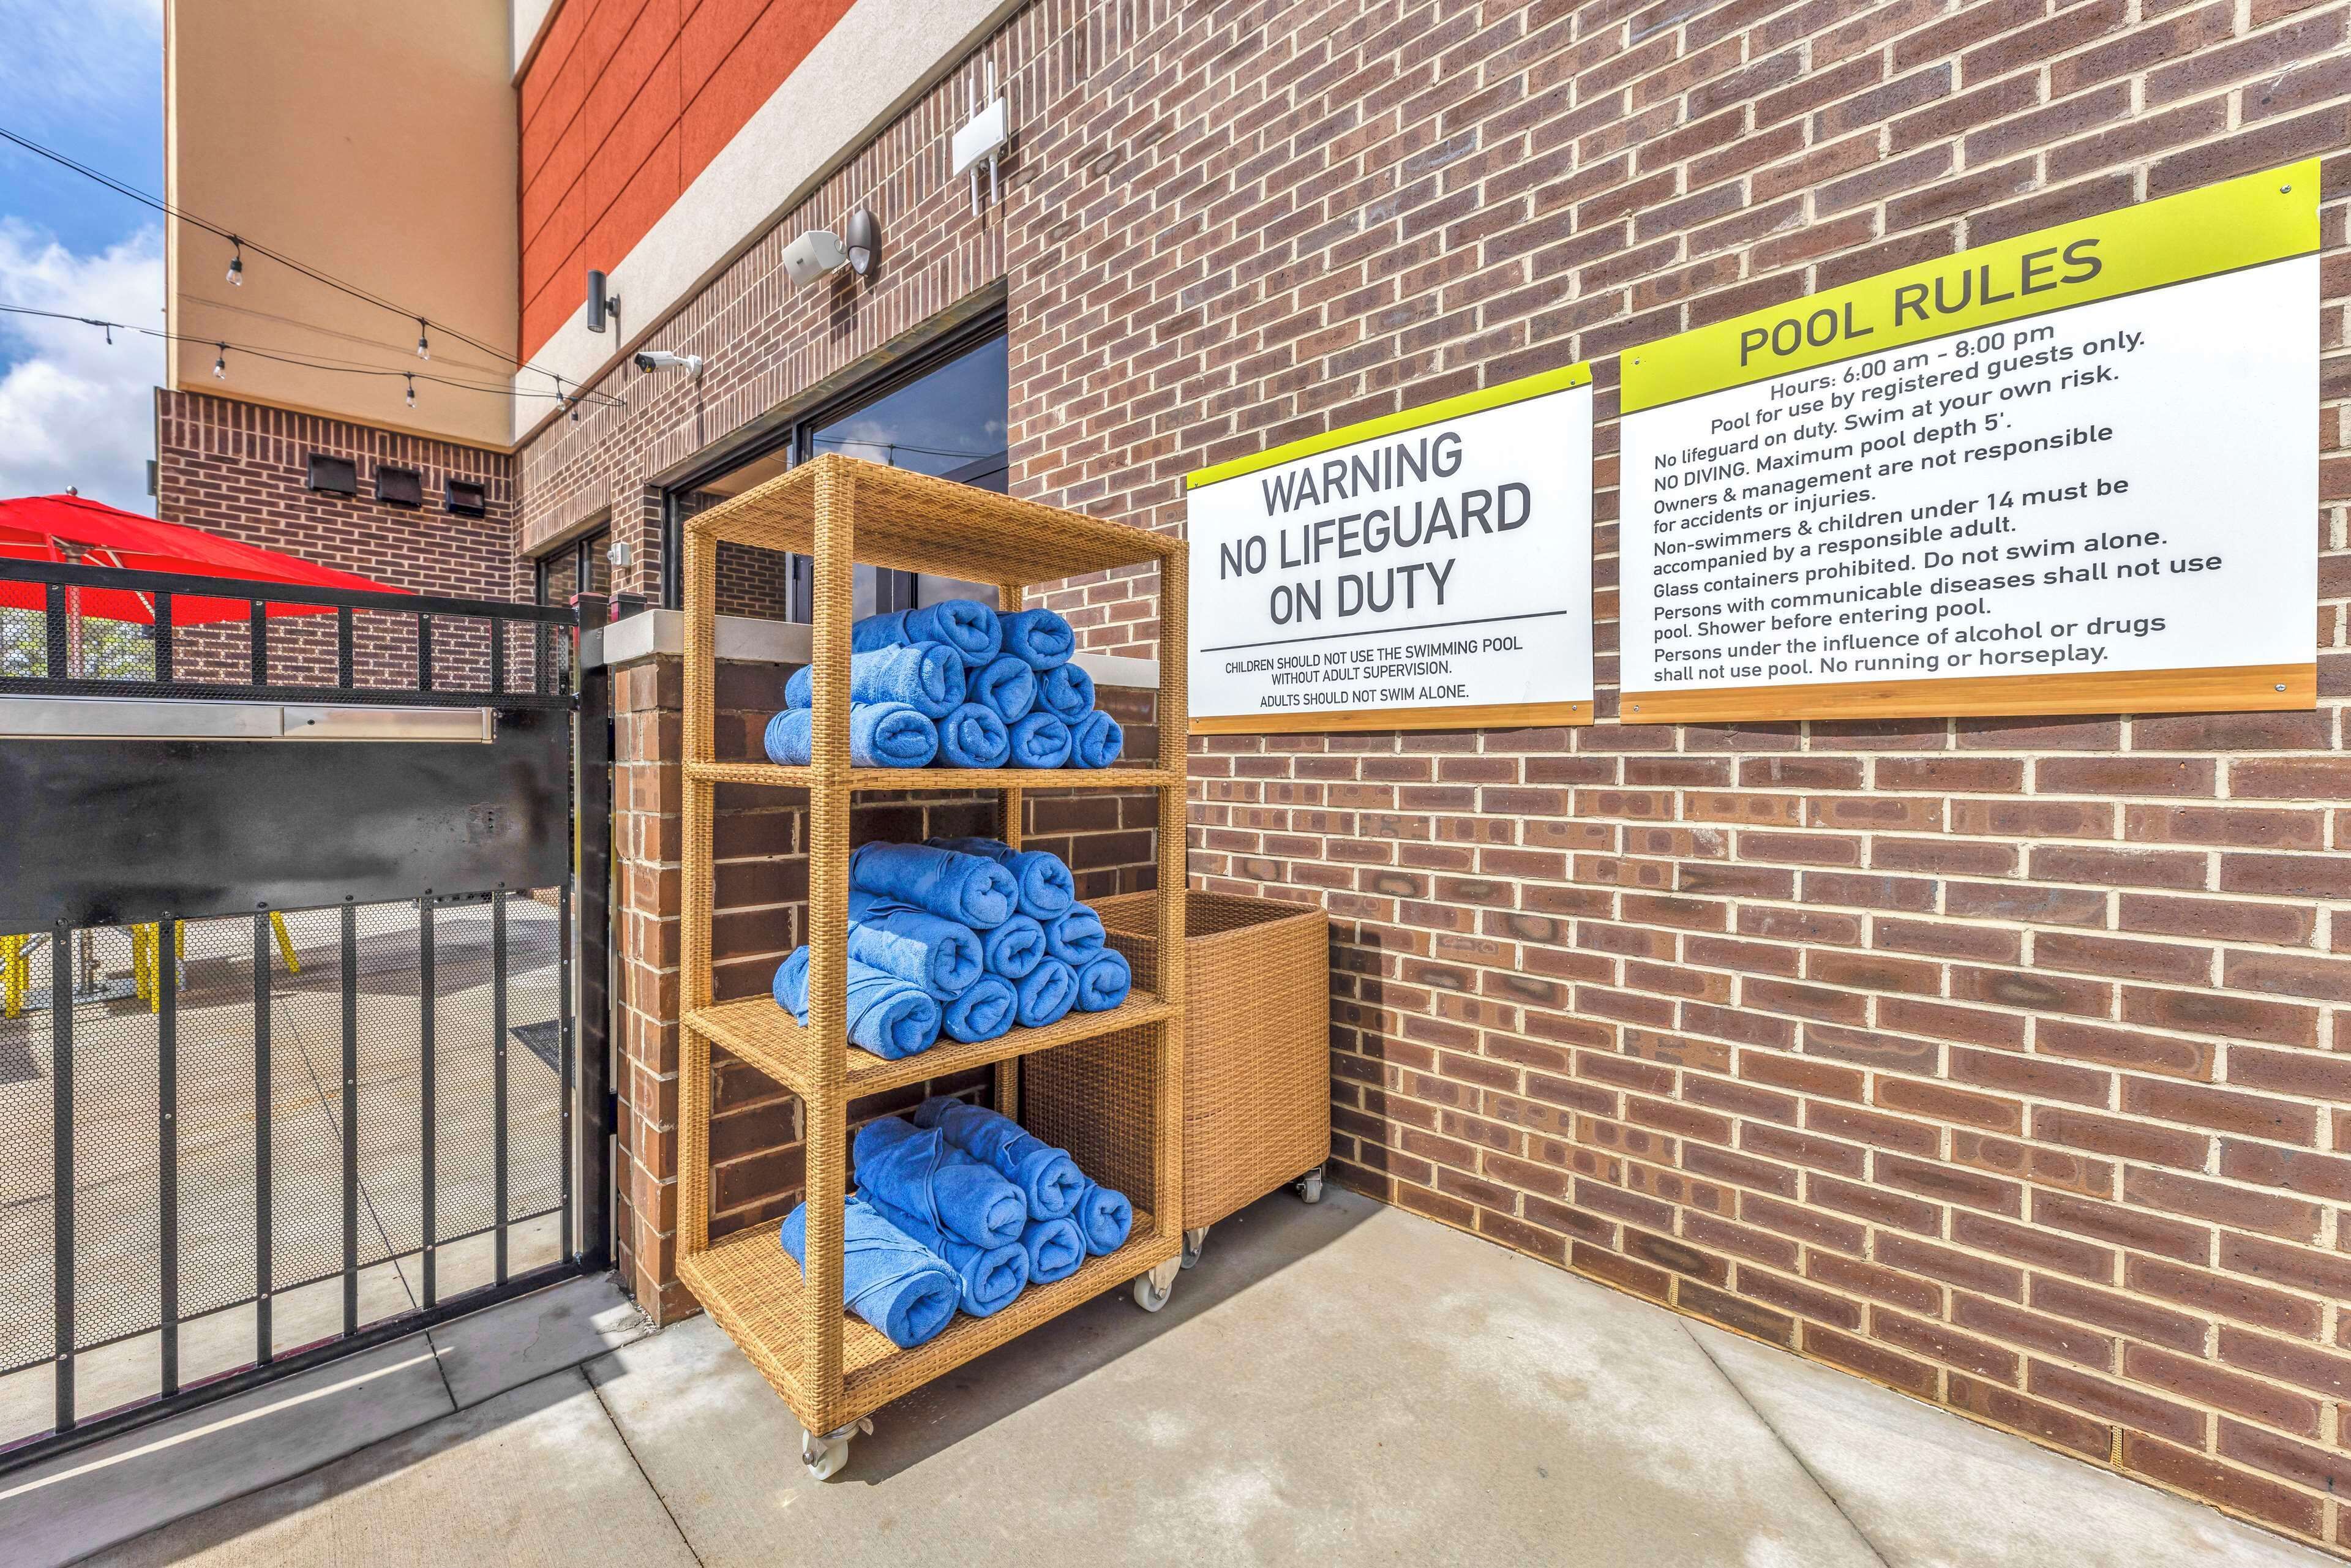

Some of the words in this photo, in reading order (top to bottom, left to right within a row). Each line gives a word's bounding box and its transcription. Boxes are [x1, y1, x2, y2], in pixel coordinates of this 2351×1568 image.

[1741, 302, 1873, 367] POOL
[1895, 239, 2101, 326] RULES
[1712, 412, 1750, 434] Pool
[1756, 409, 1783, 424] for
[1790, 400, 1823, 416] use
[1832, 392, 1854, 410] by
[1862, 361, 1978, 402] registered
[1988, 346, 2073, 380] guests
[2083, 331, 2144, 355] only.
[1771, 377, 1835, 400] Hours:
[1843, 360, 1885, 383] 6:00
[1894, 354, 1928, 372] am
[1955, 333, 2004, 358] 8:00
[2014, 326, 2053, 350] pm
[1655, 454, 1676, 469] No
[1682, 435, 1758, 463] lifeguard
[1765, 433, 1786, 446] on
[1794, 422, 1837, 440] duty.
[1845, 409, 1903, 430] Swim
[1912, 400, 1932, 417] at
[1939, 391, 1992, 416] your
[2000, 380, 2050, 400] own
[2062, 365, 2118, 389] risk.
[1262, 432, 1461, 516] WARNING
[1654, 495, 1717, 514] Owners
[1723, 488, 1736, 502] &
[1743, 464, 1871, 499] management
[1878, 460, 1913, 476] are
[1922, 450, 1956, 469] not
[1965, 425, 2112, 462] responsible
[1655, 475, 1678, 492] NO
[1685, 462, 1749, 486] DIVING.
[1757, 445, 1853, 473] Maximum
[1861, 431, 1905, 457] pool
[1914, 419, 1976, 443] depth
[1221, 536, 1266, 580] NO
[1281, 482, 1530, 569] LIFEGUARD
[1654, 520, 1676, 533] for
[1681, 506, 1762, 529] accidents
[1769, 503, 1788, 515] or
[1795, 489, 1875, 513] injuries.
[1655, 527, 1791, 556] Non-swimmers
[1798, 520, 1812, 535] &
[1818, 511, 1902, 533] children
[1911, 500, 1979, 520] under
[1988, 491, 2014, 510] 14
[2023, 482, 2087, 506] must
[2098, 479, 2128, 496] be
[1654, 547, 1766, 576] accompanied
[1774, 546, 1794, 563] by
[1801, 546, 1810, 557] a
[1818, 526, 1942, 555] responsible
[1950, 517, 2015, 538] adult.
[1654, 583, 1698, 598] Glass
[1704, 572, 1798, 592] containers
[1806, 555, 1915, 585] prohibited.
[1925, 552, 1953, 568] Do
[1962, 546, 1998, 565] not
[2006, 539, 2074, 560] swim
[2084, 532, 2167, 552] alone.
[1270, 580, 1321, 625] ON
[1338, 558, 1455, 617] DUTY
[1655, 604, 1722, 620] Persons
[1727, 596, 1764, 613] with
[1771, 582, 1922, 609] communicable
[1930, 574, 2034, 595] diseases
[2043, 562, 2107, 584] shall
[2118, 558, 2159, 578] not
[2170, 557, 2222, 573] use
[1655, 624, 1692, 643] pool.
[1698, 620, 1766, 636] Shower
[1772, 613, 1832, 630] before
[1839, 605, 1927, 625] entering
[1937, 598, 1990, 621] pool.
[1226, 659, 1273, 673] CHILDREN
[1277, 655, 1320, 669] SHOULD
[1324, 651, 1347, 665] NOT
[1351, 649, 1374, 662] USE
[1377, 647, 1401, 661] THE
[1406, 640, 1477, 658] SWIMMING
[1483, 636, 1523, 652] POOL
[1654, 666, 1693, 681] shall
[1699, 666, 1724, 679] not
[1731, 666, 1761, 677] use
[1769, 659, 1812, 680] pool.
[1821, 658, 1847, 673] No
[1855, 653, 1938, 672] running
[1948, 654, 1972, 666] or
[1980, 644, 2107, 666] horseplay.
[1655, 648, 1722, 662] Persons
[1728, 641, 1782, 657] under
[1787, 639, 1816, 653] the
[1824, 634, 1919, 651] influence
[1927, 628, 1948, 644] of
[1955, 621, 2042, 643] alcohol
[2051, 623, 2078, 637] or
[2087, 617, 2165, 637] drugs
[1261, 694, 1300, 707] ADULTS
[1303, 691, 1348, 705] SHOULD
[1353, 689, 1376, 703] NOT
[1380, 688, 1414, 701] SWIM
[1419, 685, 1469, 699] ALONE.
[1272, 670, 1319, 685] WITHOUT
[1322, 667, 1360, 682] ADULT
[1363, 661, 1452, 678] SUPERVISION.
